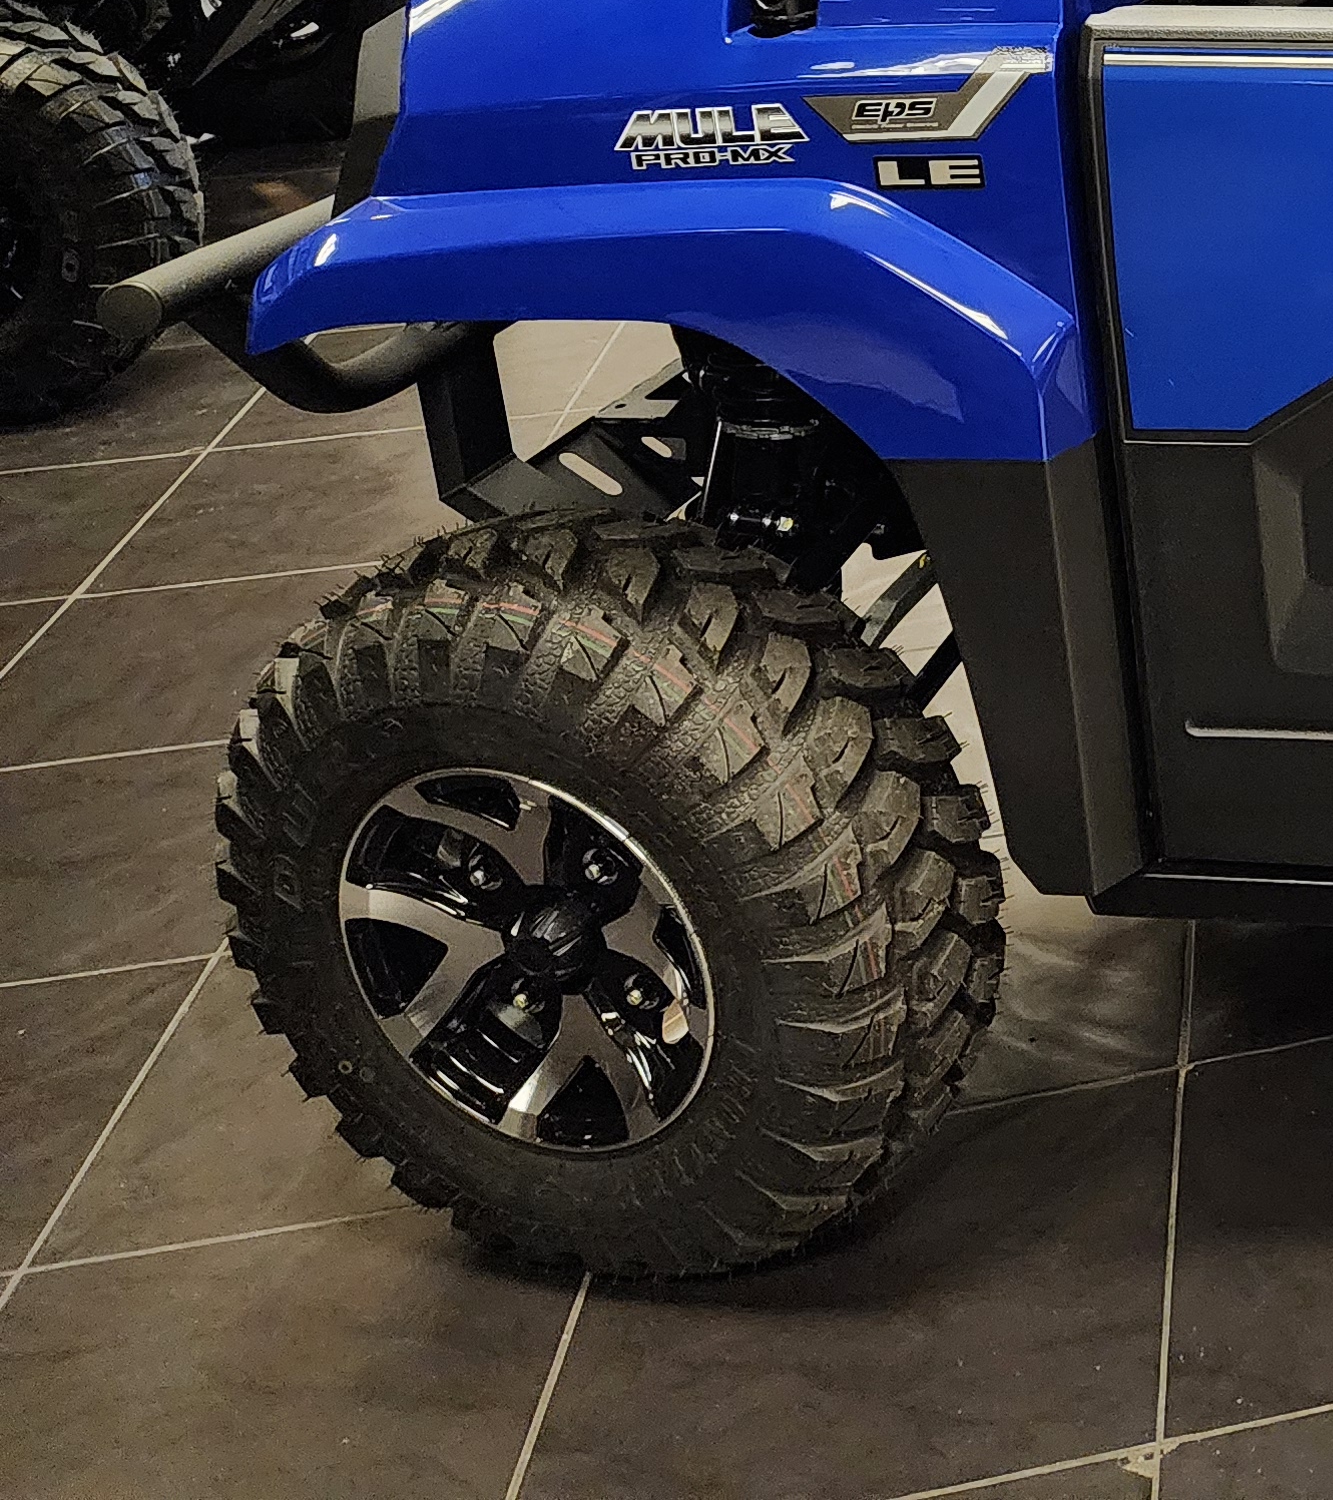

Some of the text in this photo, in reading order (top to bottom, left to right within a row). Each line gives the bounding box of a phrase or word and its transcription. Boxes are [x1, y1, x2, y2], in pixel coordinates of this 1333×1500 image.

[613, 103, 810, 151] MULE
[630, 143, 796, 171] PRO-MX
[876, 158, 983, 188] LE
